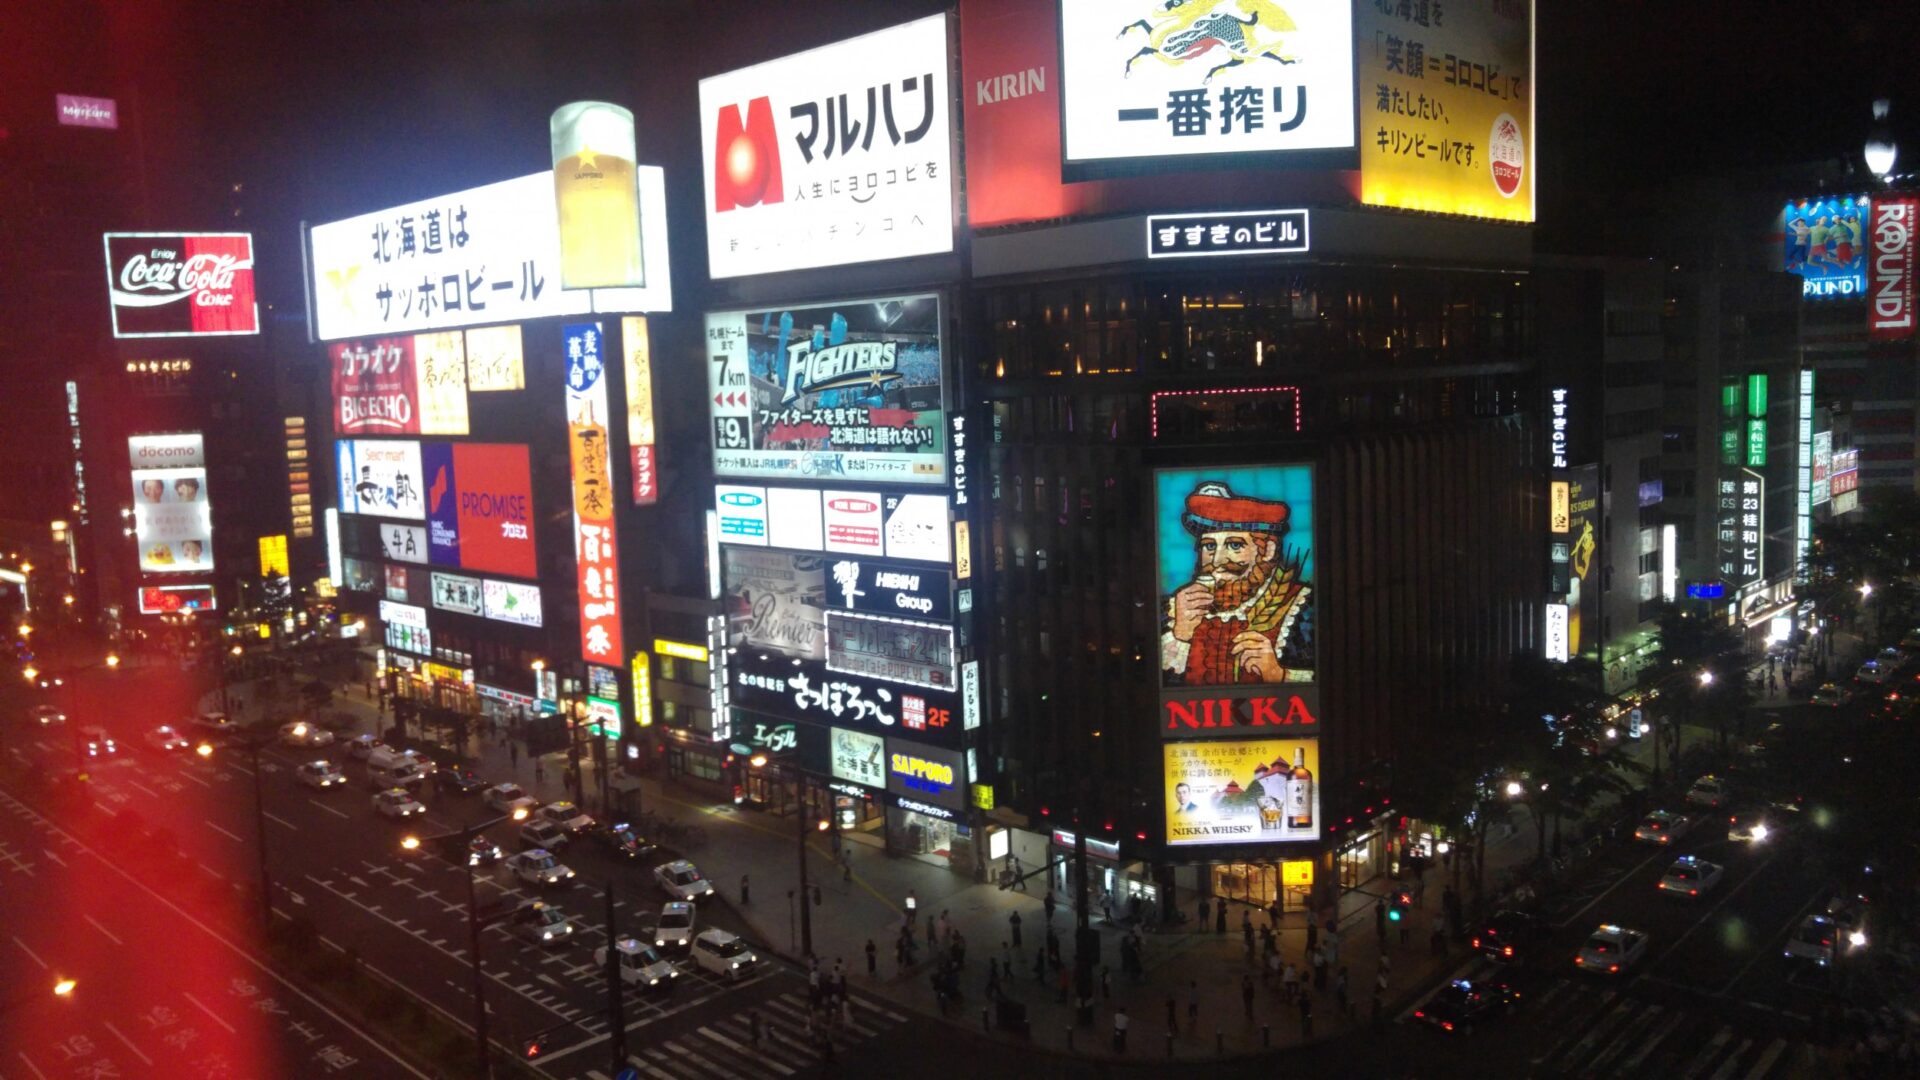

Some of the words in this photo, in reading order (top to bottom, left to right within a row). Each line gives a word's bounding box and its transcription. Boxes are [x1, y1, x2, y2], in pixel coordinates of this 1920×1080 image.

[976, 66, 1046, 106] KIRIN
[790, 72, 935, 165] マルハン
[1117, 85, 1308, 137] 一番搾り
[795, 161, 938, 202] 人生にヨロコビを
[372, 204, 470, 264] 北海道は
[1158, 221, 1299, 247] すすきのビル
[151, 248, 176, 260] Enjoy
[121, 253, 236, 291] Coca-Cola
[196, 290, 234, 307] Coke
[375, 260, 545, 322] サッポロビール
[340, 345, 404, 377] カラオケ
[780, 338, 898, 405] FIGHTERS
[759, 407, 870, 426] ファイターズを見ずに
[1552, 388, 1568, 468] すすきのビル
[138, 444, 196, 459] docomo
[952, 416, 968, 505] すすきのビル
[637, 446, 652, 497] カラオケ
[462, 492, 527, 521] PROMISE
[501, 521, 528, 540] プロミス
[896, 592, 933, 613] Group
[788, 672, 895, 726] さっぽろっこ
[1165, 695, 1317, 729] NIKKA
[928, 707, 950, 728] 2F
[753, 724, 797, 752] エイブル
[891, 753, 953, 785] SAPPORO
[1173, 826, 1210, 836] NIKKA
[1212, 824, 1253, 834] WHISKY
